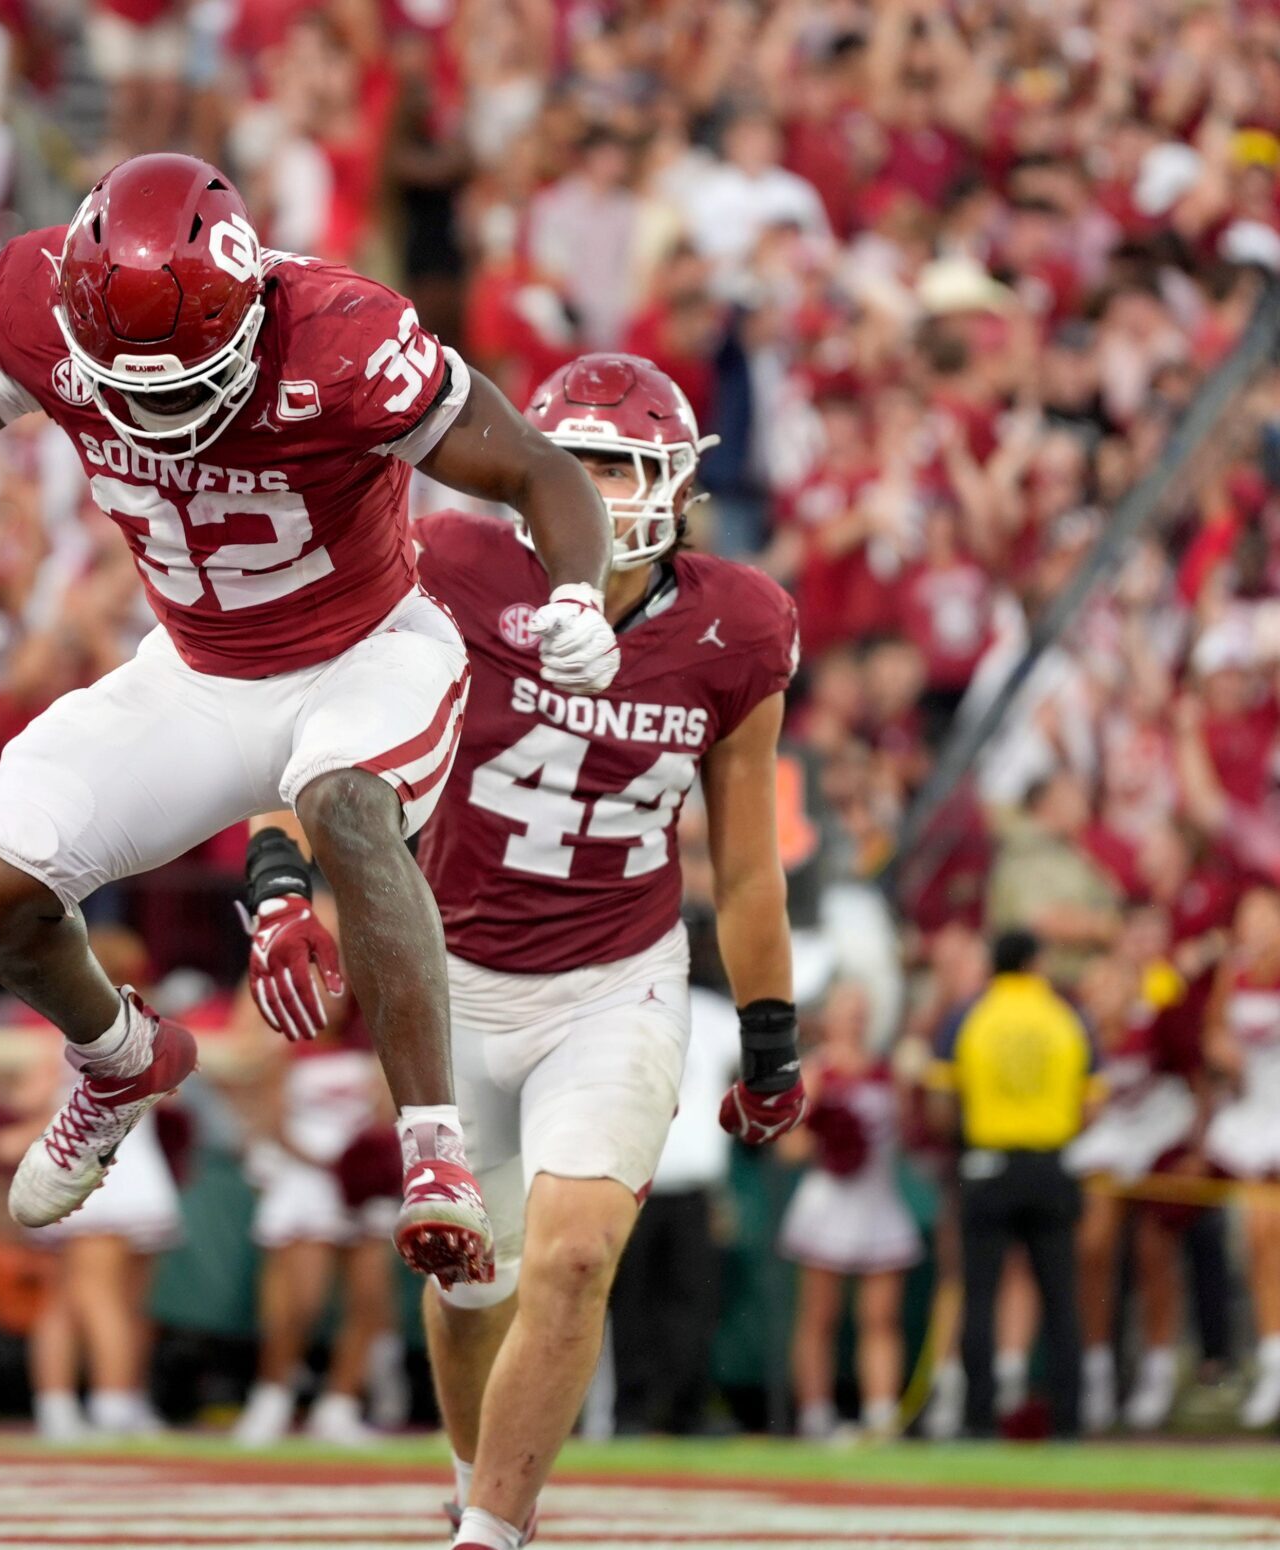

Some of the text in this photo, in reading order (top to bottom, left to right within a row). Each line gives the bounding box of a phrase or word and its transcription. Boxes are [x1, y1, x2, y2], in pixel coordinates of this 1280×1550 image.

[208, 212, 260, 283] OU
[365, 307, 437, 413] 32
[279, 384, 318, 417] C
[79, 431, 290, 494] SOONERS
[90, 473, 336, 612] 32
[511, 677, 708, 746] SOONERS
[468, 723, 700, 879] 44
